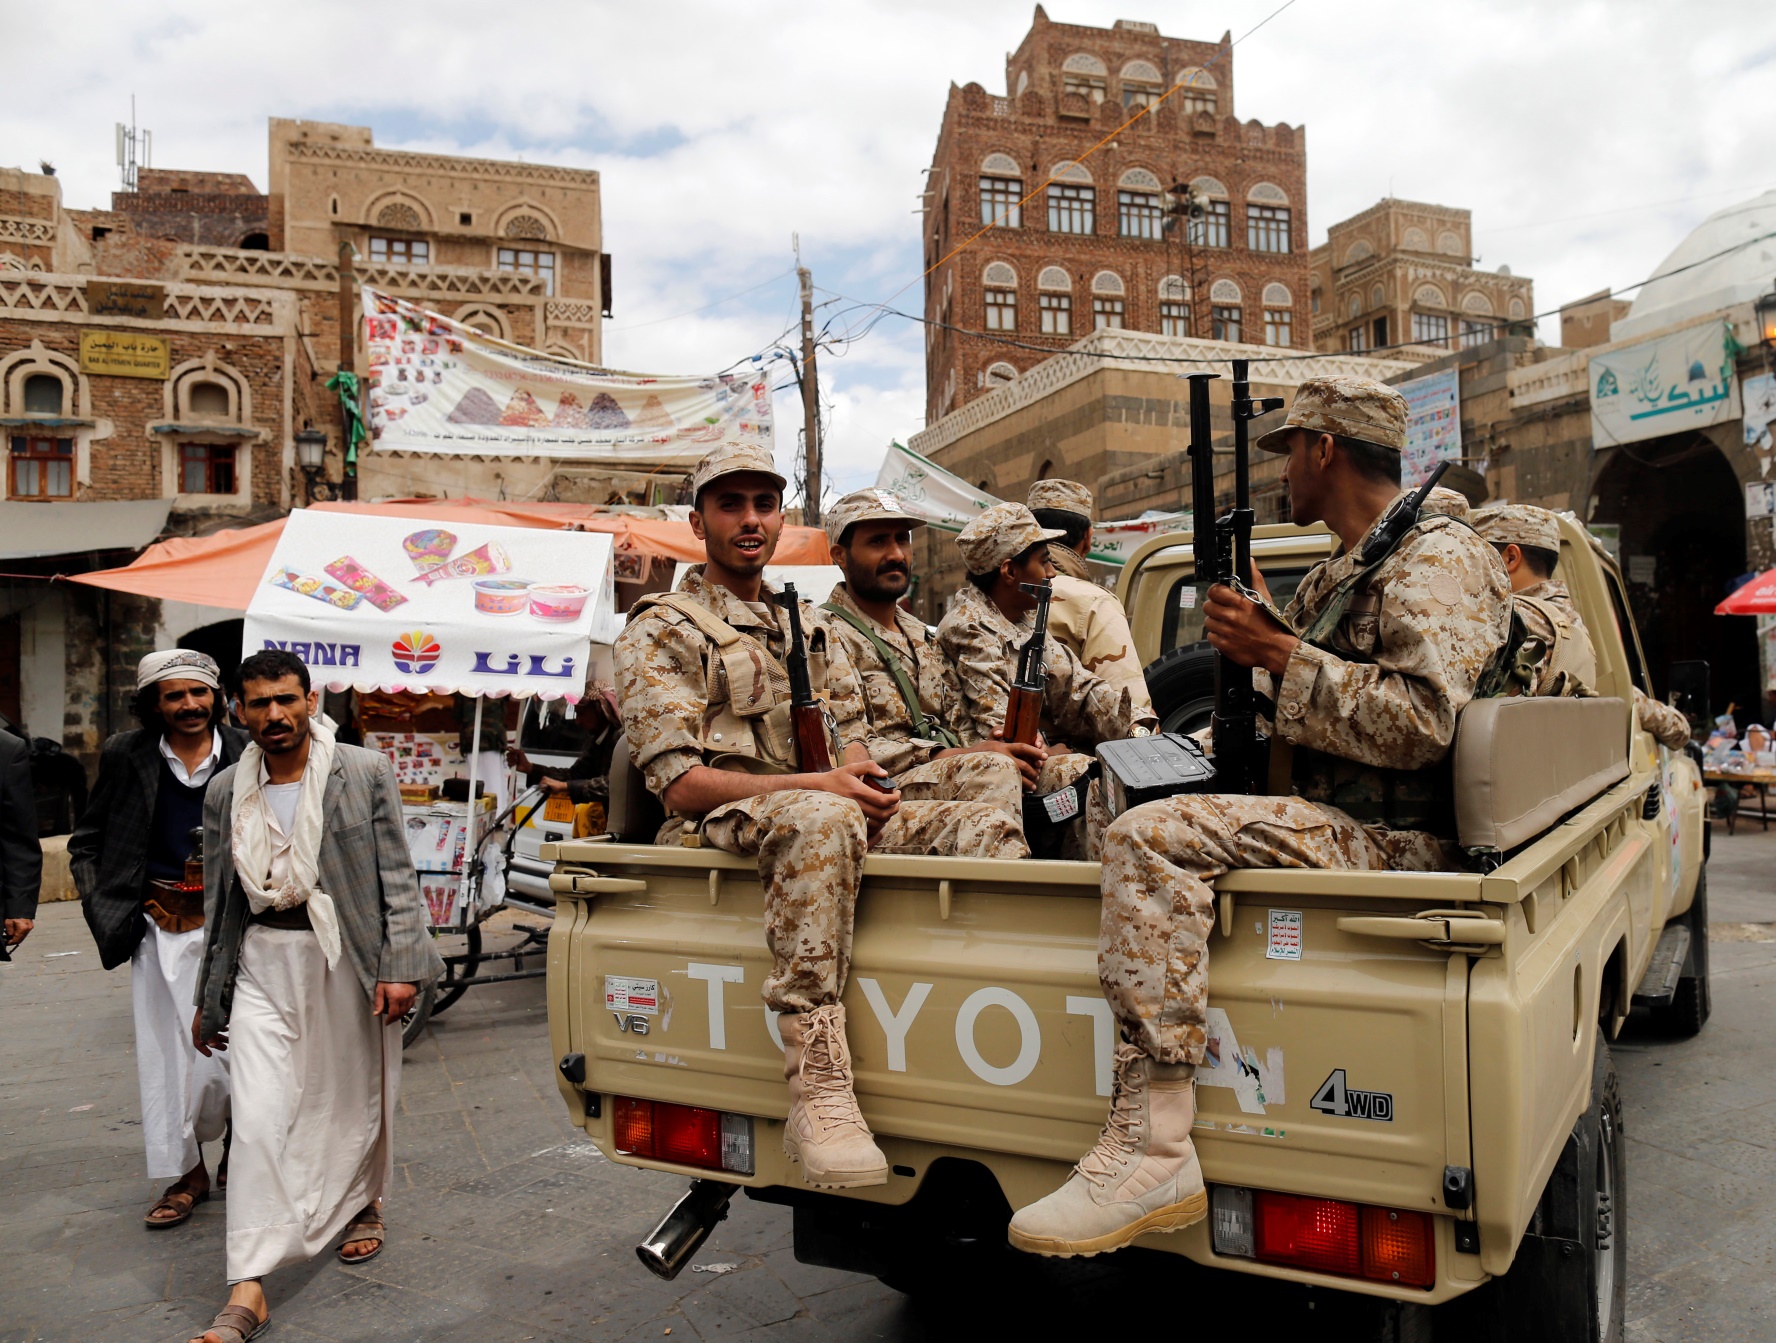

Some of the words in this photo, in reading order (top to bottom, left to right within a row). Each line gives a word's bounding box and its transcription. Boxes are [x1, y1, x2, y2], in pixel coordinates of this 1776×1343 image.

[90, 340, 118, 350] اليمن
[122, 343, 137, 352] باب
[141, 343, 158, 353] حارة
[1091, 536, 1123, 552] الحرية
[1272, 914, 1289, 924] أكبر
[1289, 914, 1300, 923] الله
[613, 1012, 650, 1035] V6
[688, 962, 1266, 1115] TYOTA
[1310, 1068, 1393, 1122] 4WD
